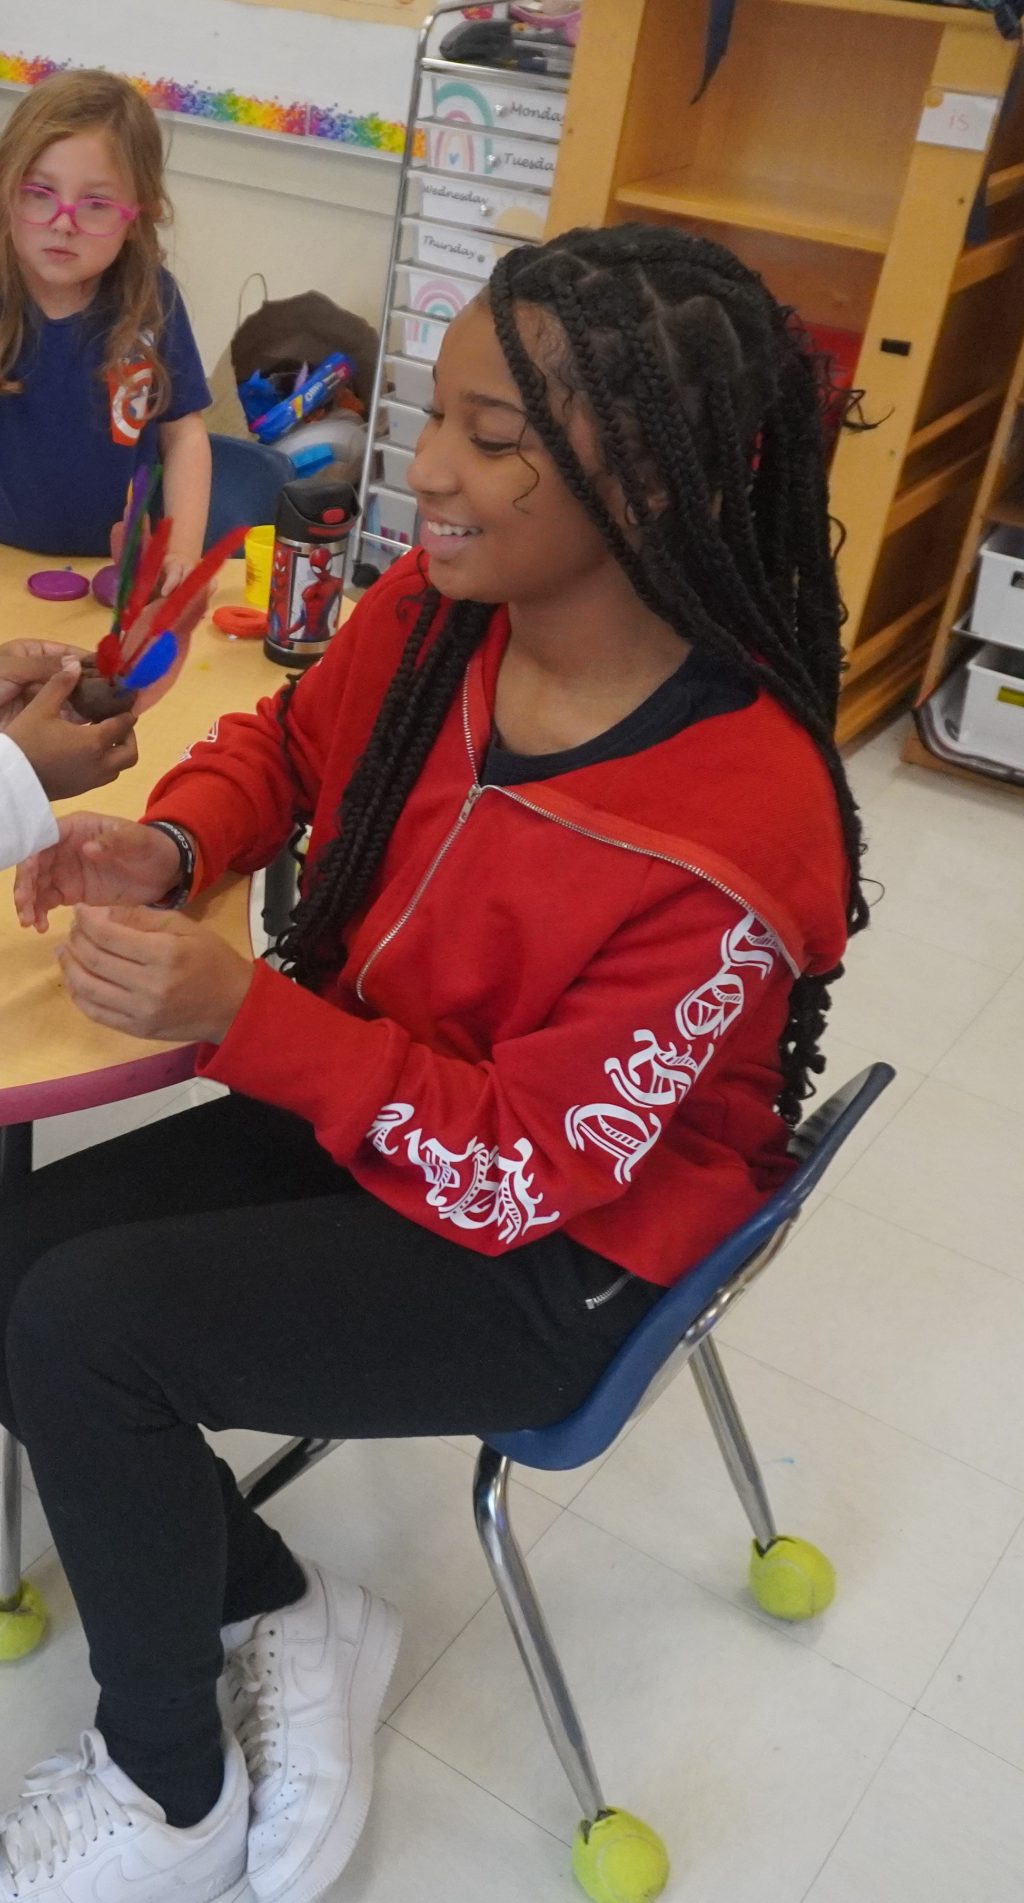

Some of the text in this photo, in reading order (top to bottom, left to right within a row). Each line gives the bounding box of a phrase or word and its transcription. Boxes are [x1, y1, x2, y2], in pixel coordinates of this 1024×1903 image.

[511, 101, 566, 126] Monda
[503, 152, 555, 172] Tuesda
[423, 235, 476, 259] Thursday
